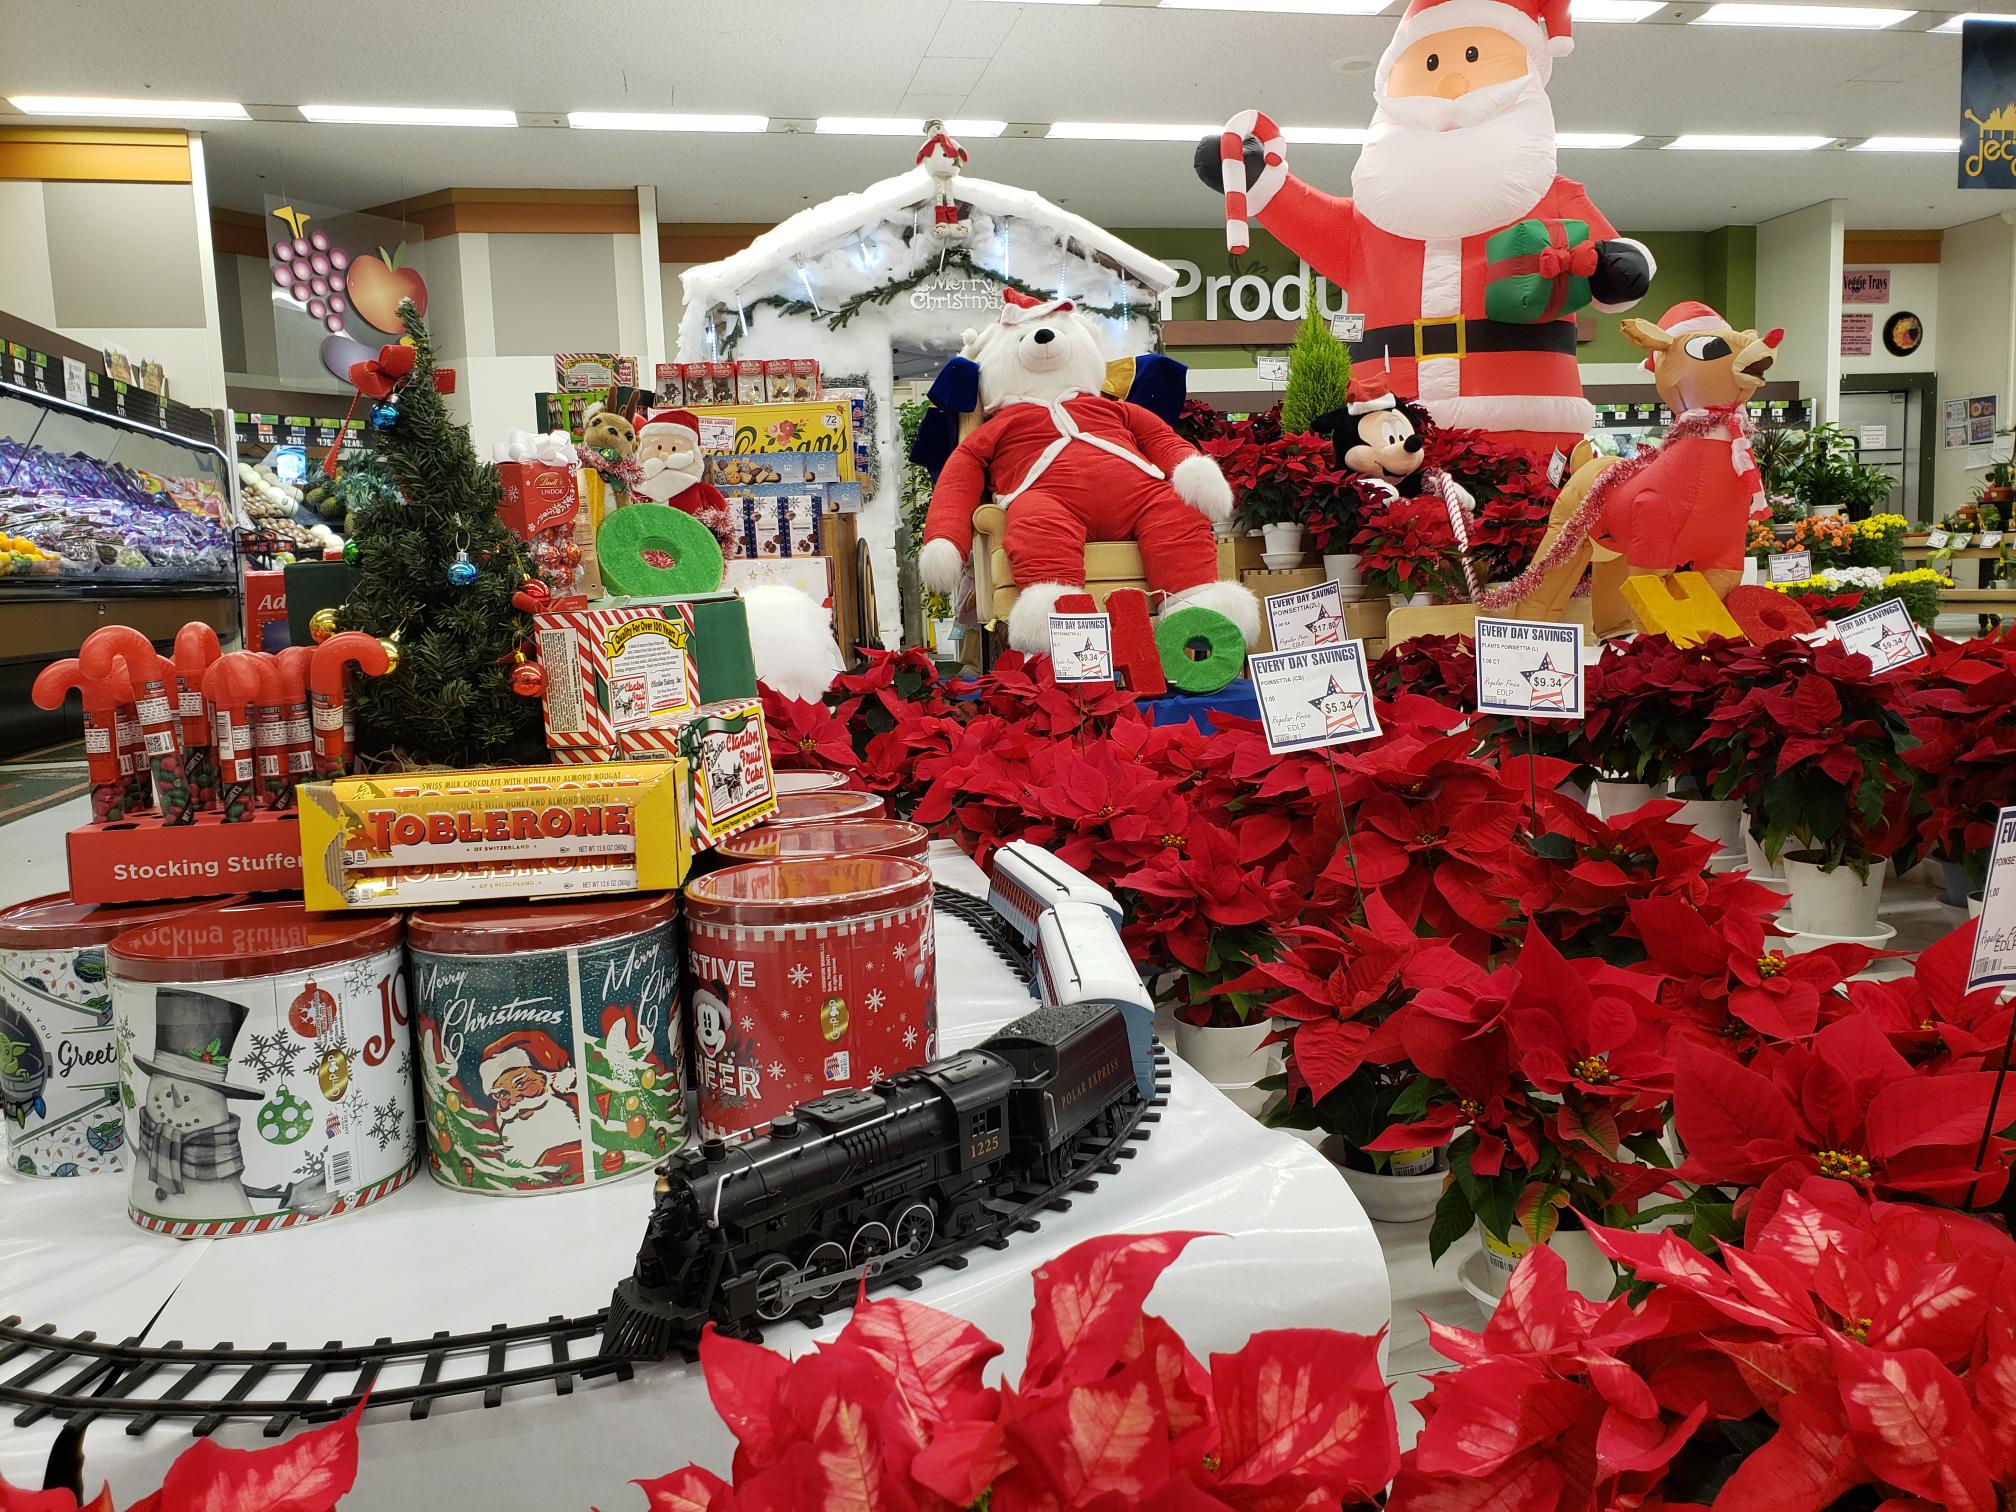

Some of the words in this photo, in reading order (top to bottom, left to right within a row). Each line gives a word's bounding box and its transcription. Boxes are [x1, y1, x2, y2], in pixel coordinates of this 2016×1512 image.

[930, 278, 994, 294] Merry
[1868, 274, 1888, 292] Trays
[826, 415, 837, 424] 72
[540, 488, 563, 496] LINDOR
[258, 593, 287, 610] Ad
[1272, 596, 1294, 609] EVERY
[1296, 593, 1310, 604] DAY
[1311, 585, 1338, 600] SAVINGS
[1066, 620, 1076, 630] DAY
[1078, 620, 1105, 630] SAVINGS
[1313, 621, 1336, 633] $17.80
[1840, 622, 1856, 634] EVERY
[1855, 616, 1868, 627] DAY
[1867, 604, 1900, 622] SAVINGS
[616, 626, 632, 644] Quality
[632, 624, 640, 633] For
[640, 622, 653, 632] Over
[653, 622, 662, 631] 100
[662, 624, 676, 638] Years
[1482, 624, 1508, 638] EVERY
[1510, 626, 1530, 640] DAY
[1532, 628, 1573, 642] SAVINGS
[1882, 638, 1903, 650] $9.34
[1256, 658, 1286, 674] EVERY
[1288, 654, 1308, 670] DAY
[1310, 648, 1355, 666] SAVINGS
[1260, 678, 1292, 686] POINSETTIA
[1484, 676, 1503, 688] Regular
[1506, 678, 1520, 688] Price
[1534, 676, 1562, 688] $9.34
[1496, 688, 1514, 697] EDLP
[1325, 700, 1354, 714] $5.34
[1272, 714, 1293, 724] Regular
[1296, 712, 1312, 720] Price
[1287, 723, 1306, 732] EDLP
[702, 738, 714, 756] Old
[725, 728, 759, 753] Claxton
[739, 746, 762, 768] Fruit
[422, 781, 443, 790] SWISS
[444, 780, 461, 789] MILK
[463, 778, 502, 788] CHOCOLATE
[504, 777, 521, 786] WITH
[546, 775, 561, 783] AND
[563, 773, 592, 782] ALMOND
[594, 771, 622, 780] NOUGAT
[744, 764, 764, 784] Cake
[548, 795, 578, 806] ALMOND
[366, 804, 632, 852] TOBLERONE
[484, 843, 530, 852] SWITZERLAND
[578, 845, 588, 853] NET
[596, 844, 606, 852] 12.6
[113, 858, 220, 882] Stocking
[582, 881, 592, 889] NET
[600, 880, 610, 888] 12.6
[1981, 927, 2005, 950] Regular
[602, 942, 660, 1000] Merry
[418, 964, 468, 1002] Merry
[10, 992, 32, 1014] WITH
[36, 1017, 52, 1040] YOU
[440, 996, 566, 1064] Christmas
[1061, 1081, 1087, 1109] POLAR
[1088, 1056, 1119, 1088] EXPRESS
[970, 1136, 999, 1159] 1225
